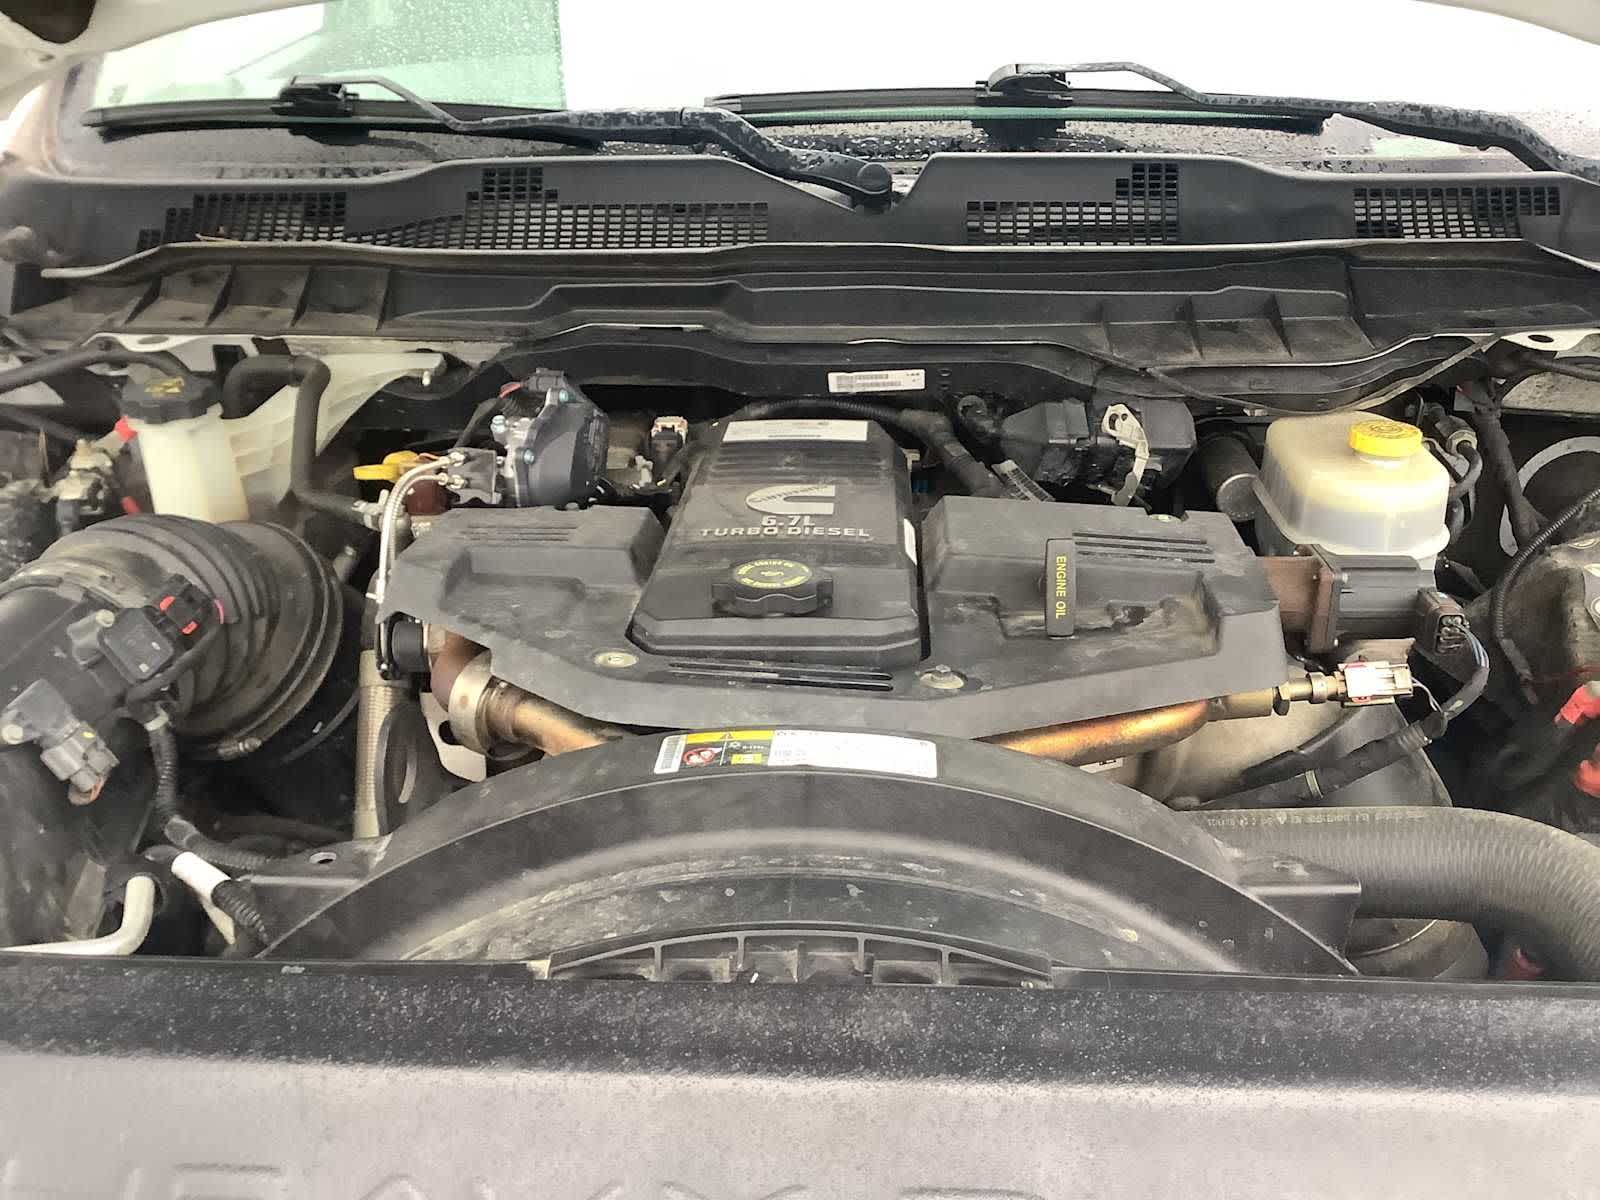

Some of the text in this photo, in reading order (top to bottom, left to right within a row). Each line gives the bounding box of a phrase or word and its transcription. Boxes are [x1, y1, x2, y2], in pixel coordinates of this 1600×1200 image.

[761, 515, 816, 527] 6.7L
[701, 527, 870, 537] TURBO DIESEL
[1056, 555, 1067, 619] ENGINE OIL
